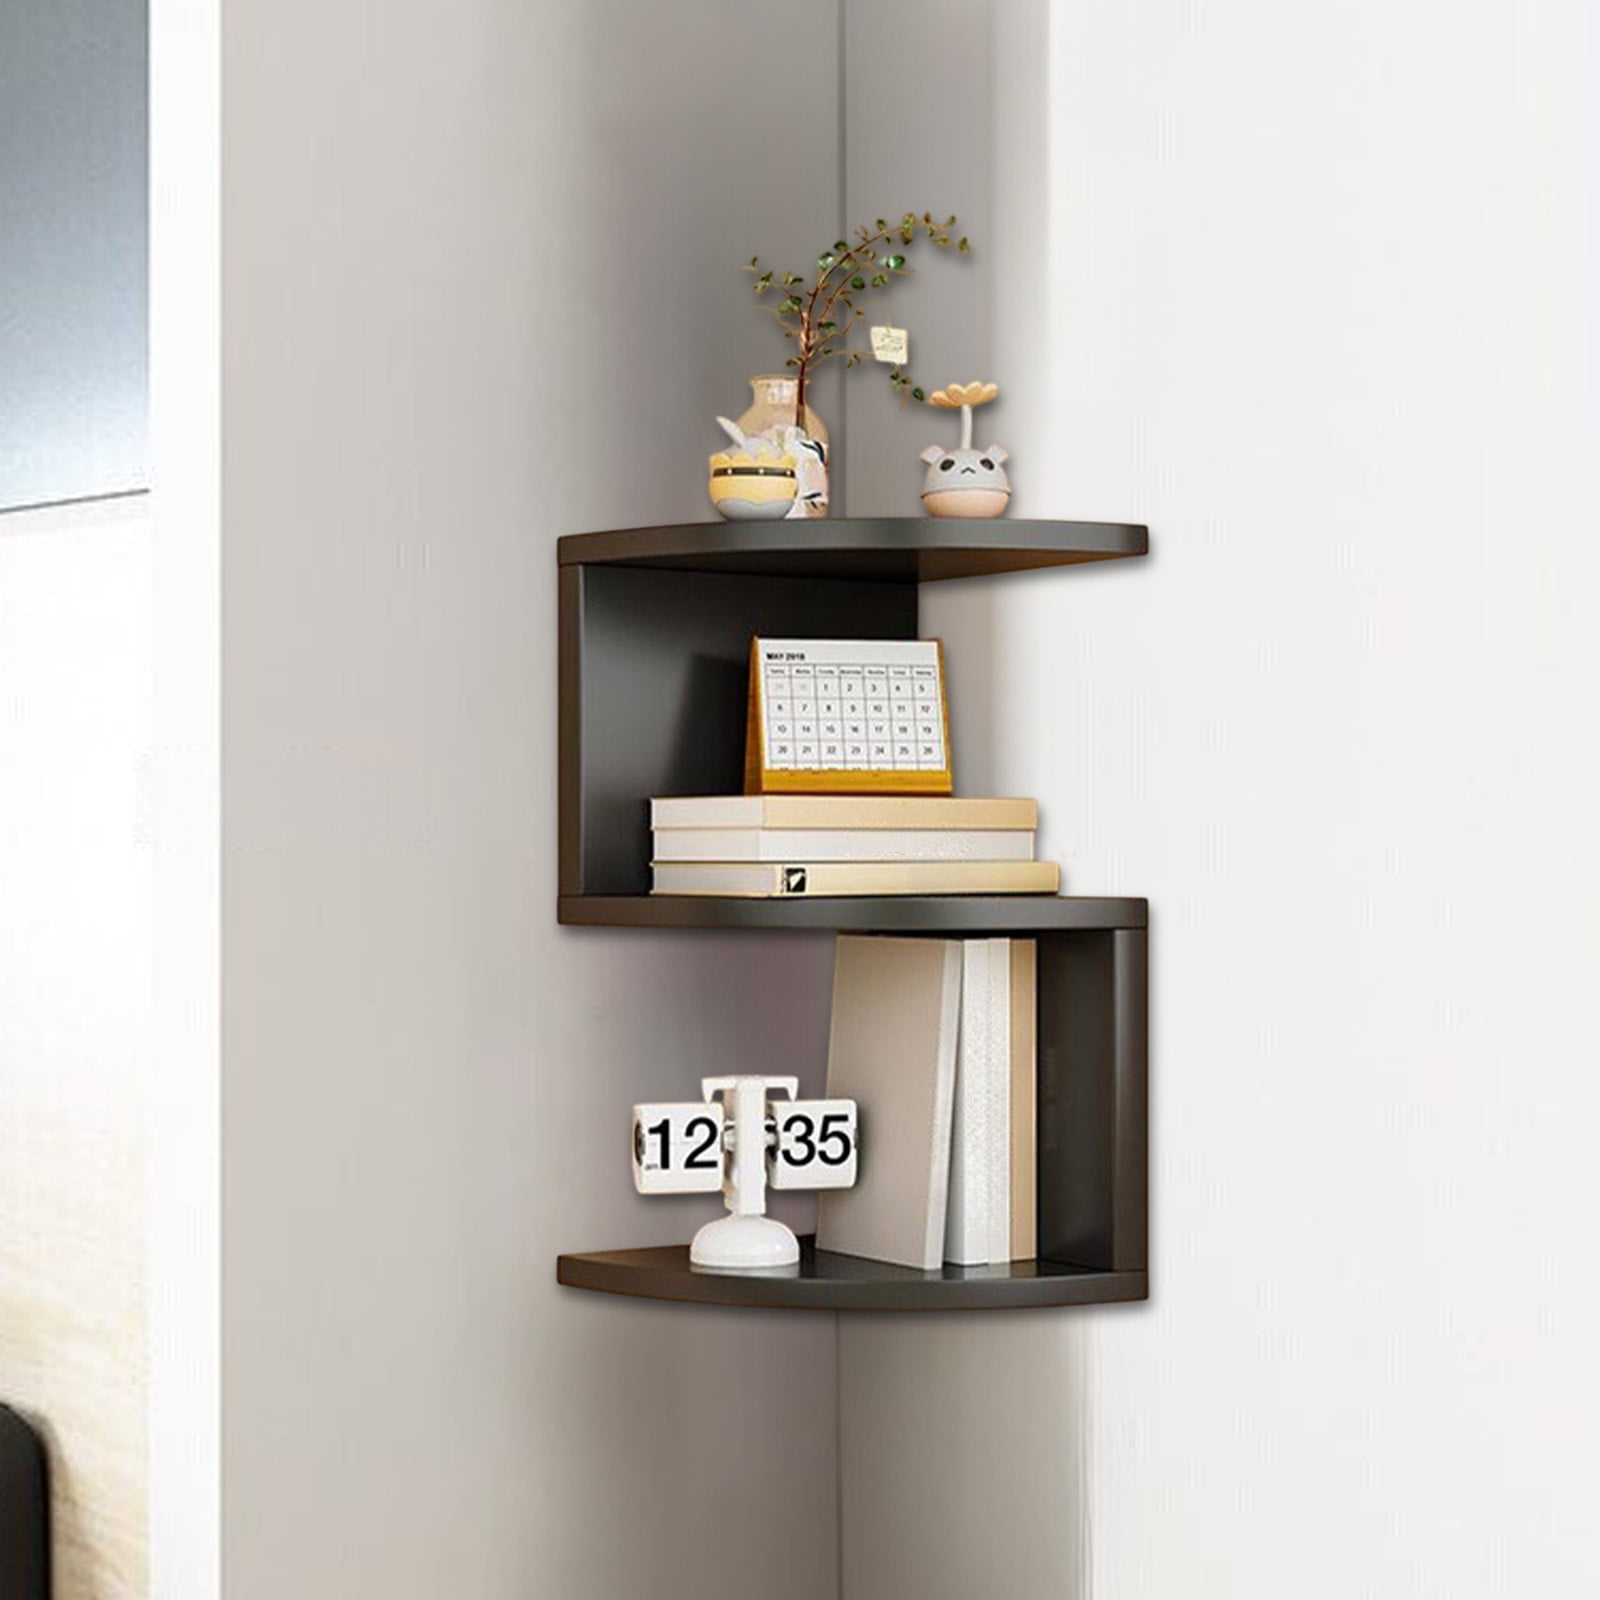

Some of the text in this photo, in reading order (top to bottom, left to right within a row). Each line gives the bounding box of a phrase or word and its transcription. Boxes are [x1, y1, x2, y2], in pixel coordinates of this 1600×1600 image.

[873, 705, 882, 713] 10
[897, 705, 906, 713] 11
[920, 705, 931, 714] 12
[802, 725, 811, 733] 14
[826, 725, 836, 734] 15
[874, 725, 884, 733] 17
[802, 746, 812, 755] 21
[851, 746, 861, 755] 23
[876, 746, 885, 755] 24
[647, 1114, 851, 1170] 12 35
